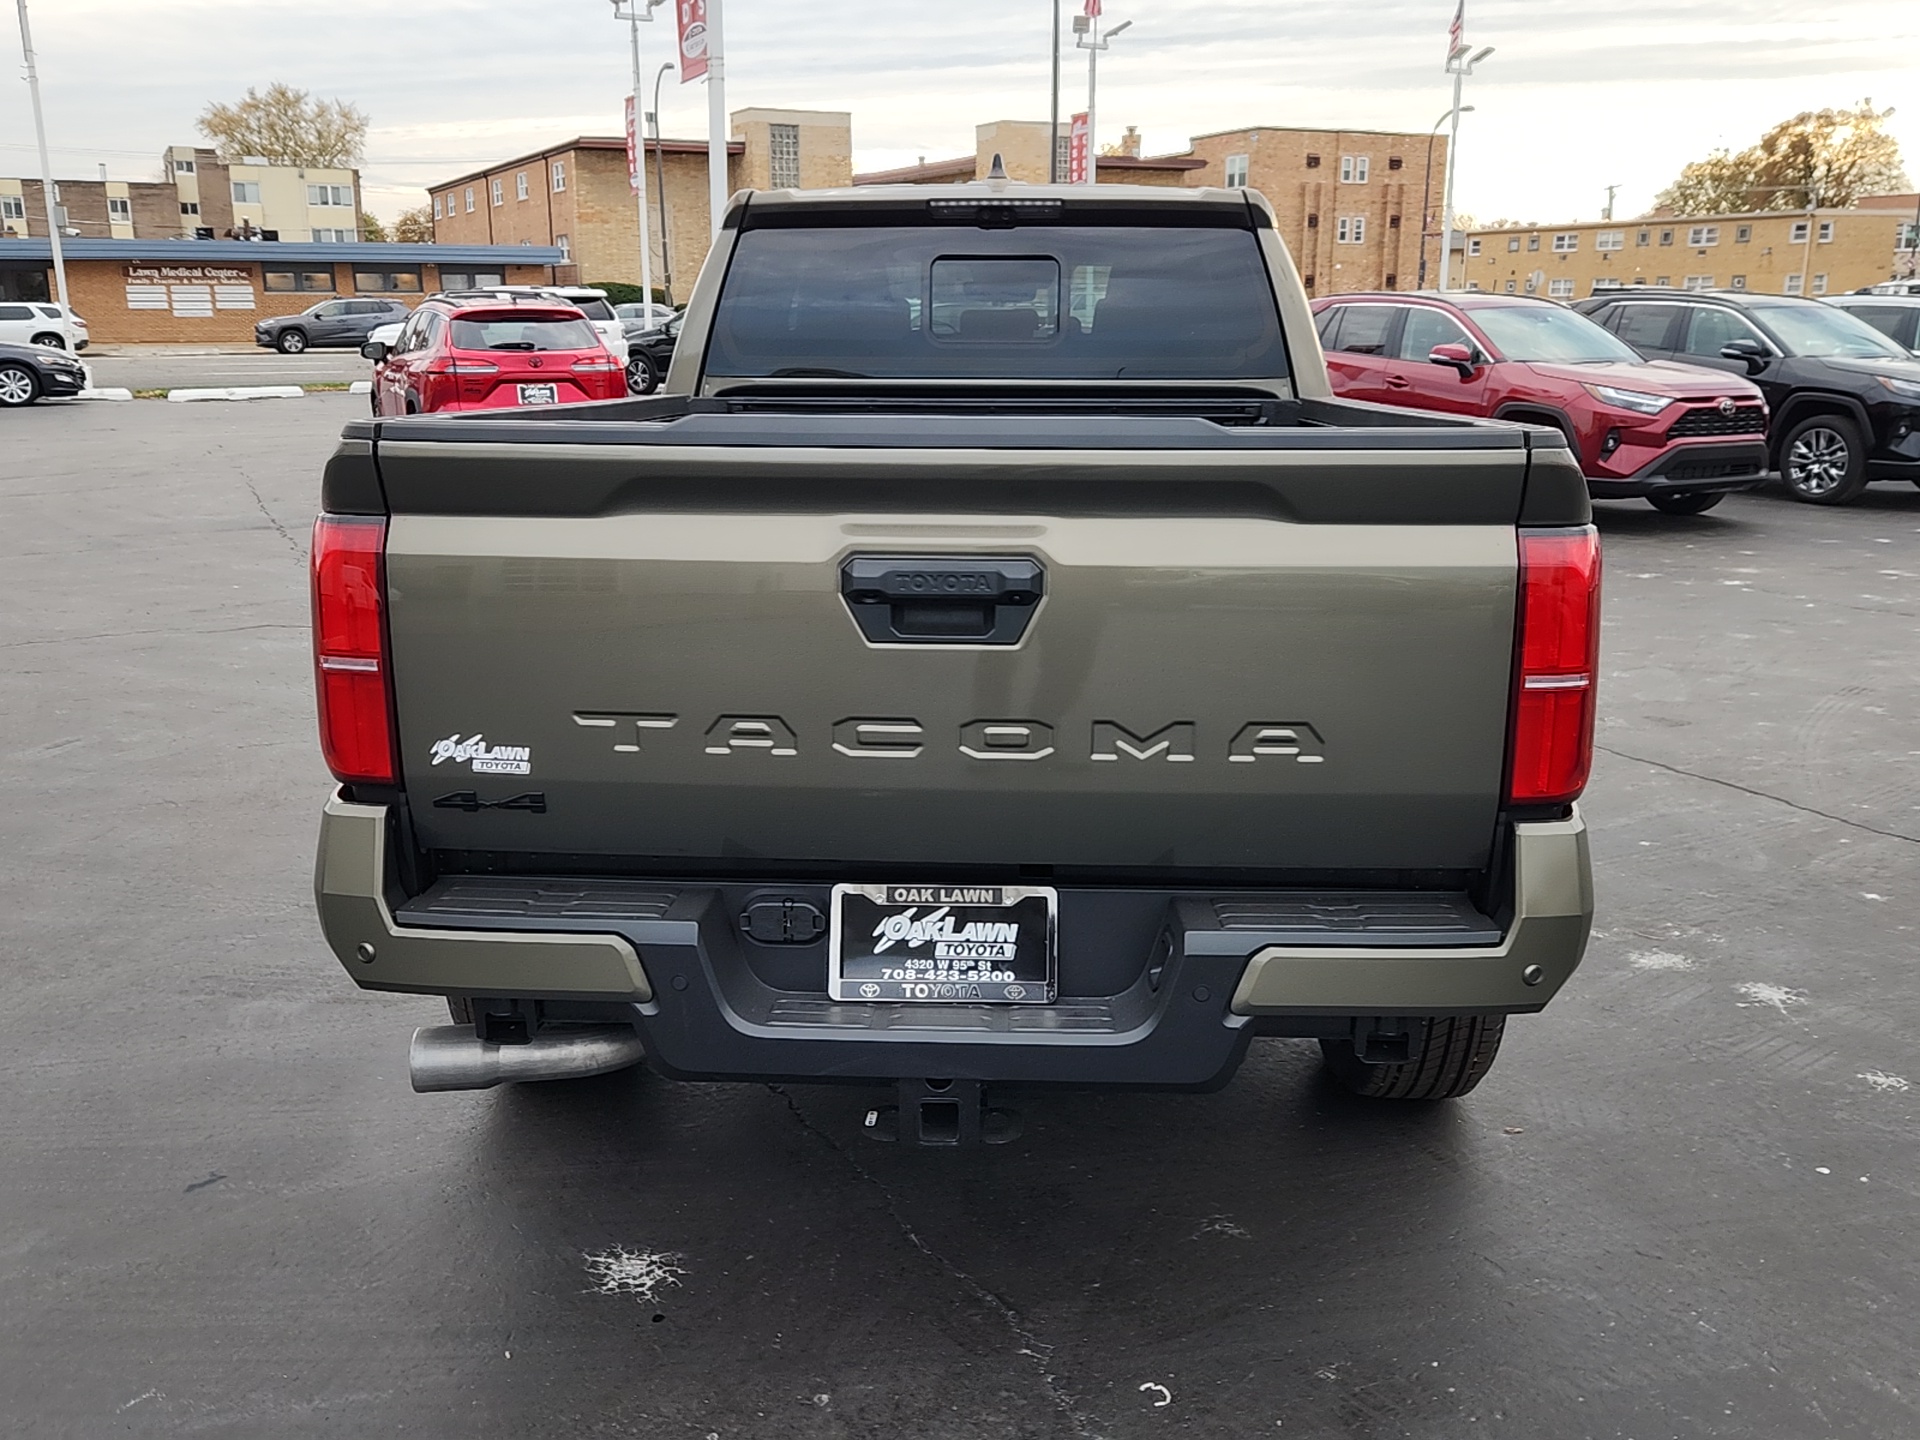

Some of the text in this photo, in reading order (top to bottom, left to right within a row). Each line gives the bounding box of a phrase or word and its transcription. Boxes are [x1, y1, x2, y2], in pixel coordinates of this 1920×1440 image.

[161, 267, 203, 277] Medical
[204, 268, 239, 278] Center
[895, 573, 992, 592] TOYOTA
[572, 710, 1326, 763] TACOMA
[479, 761, 521, 770] TOYOTA
[894, 888, 993, 903] OAK LAWN
[944, 943, 1006, 957] TOYOTA
[904, 959, 934, 969] 4320
[937, 960, 949, 969] W
[977, 960, 992, 970] St
[881, 968, 1016, 981] 708-423-5200
[901, 983, 982, 998] TOYOTA
